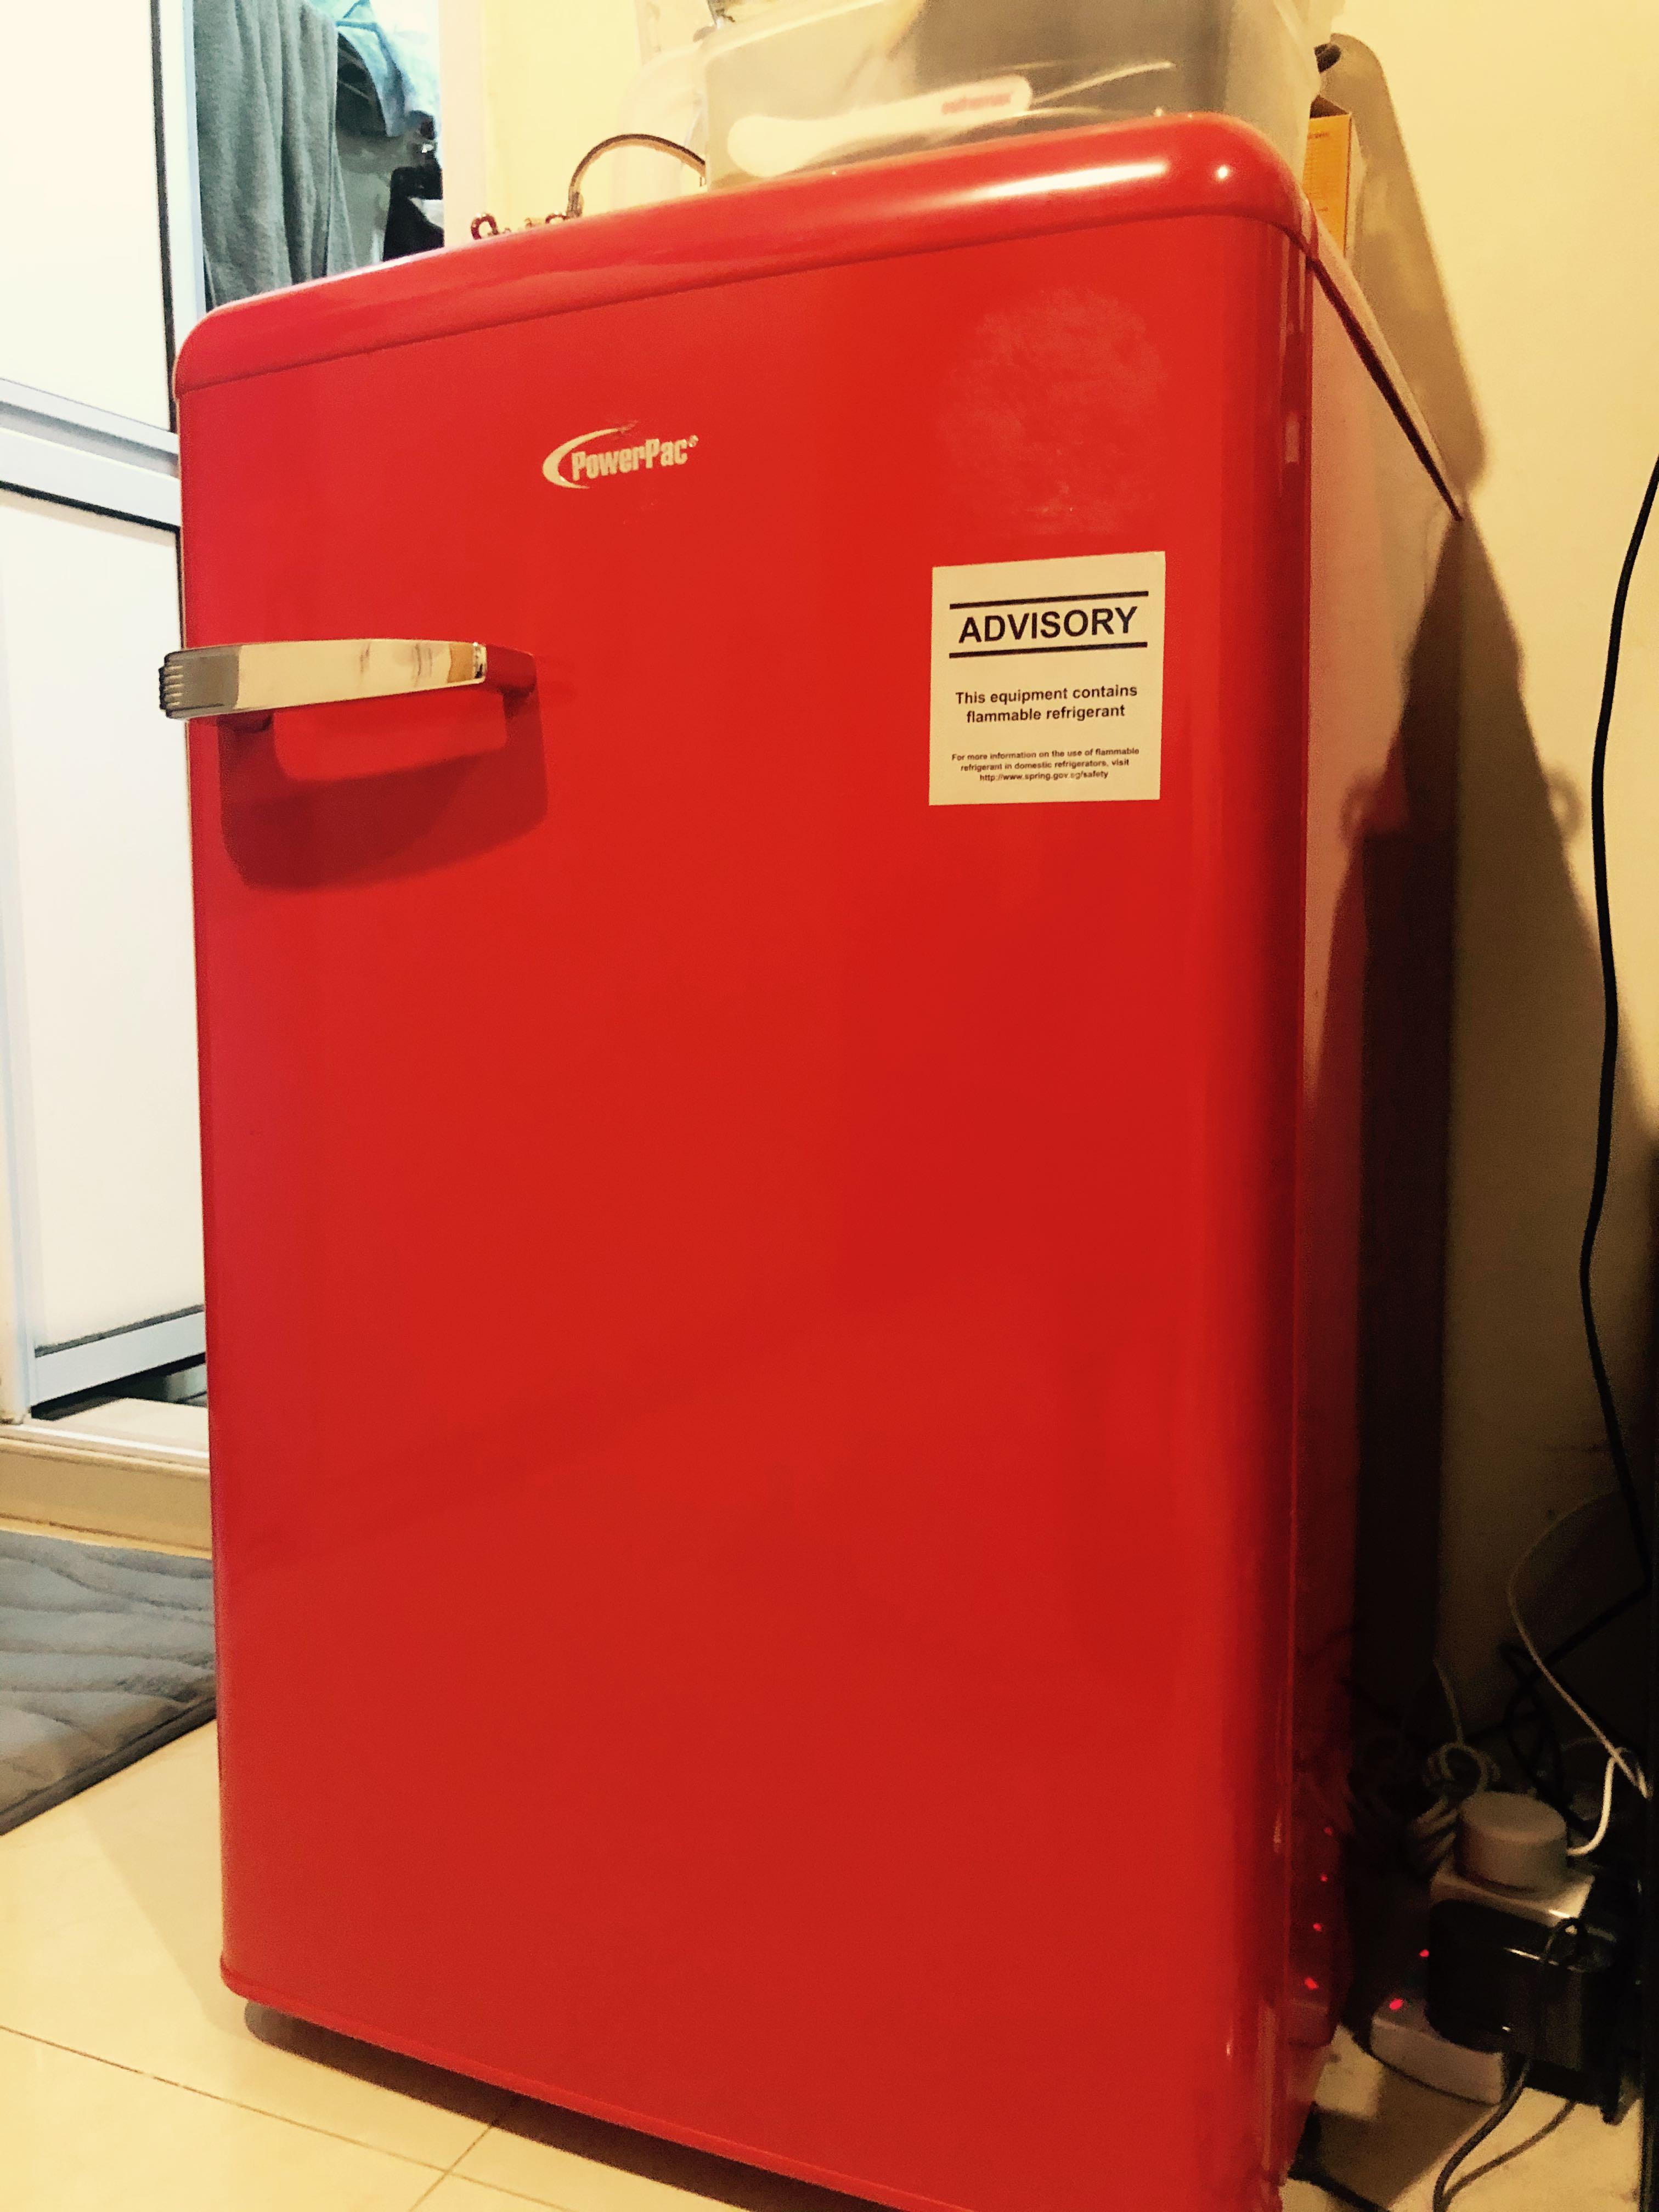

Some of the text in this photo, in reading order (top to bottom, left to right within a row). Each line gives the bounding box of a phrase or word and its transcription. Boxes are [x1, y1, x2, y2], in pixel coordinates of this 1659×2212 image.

[571, 438, 688, 481] PowerPac
[958, 606, 1138, 644] ADVISORY
[955, 684, 1137, 705] This equipment contains
[967, 704, 1125, 723] flammable refrigerant
[990, 752, 1037, 760] information
[1095, 747, 1140, 756] flammable
[961, 763, 1003, 773] refrigerant
[1014, 760, 1052, 769] domestic
[1111, 758, 1130, 766] visit
